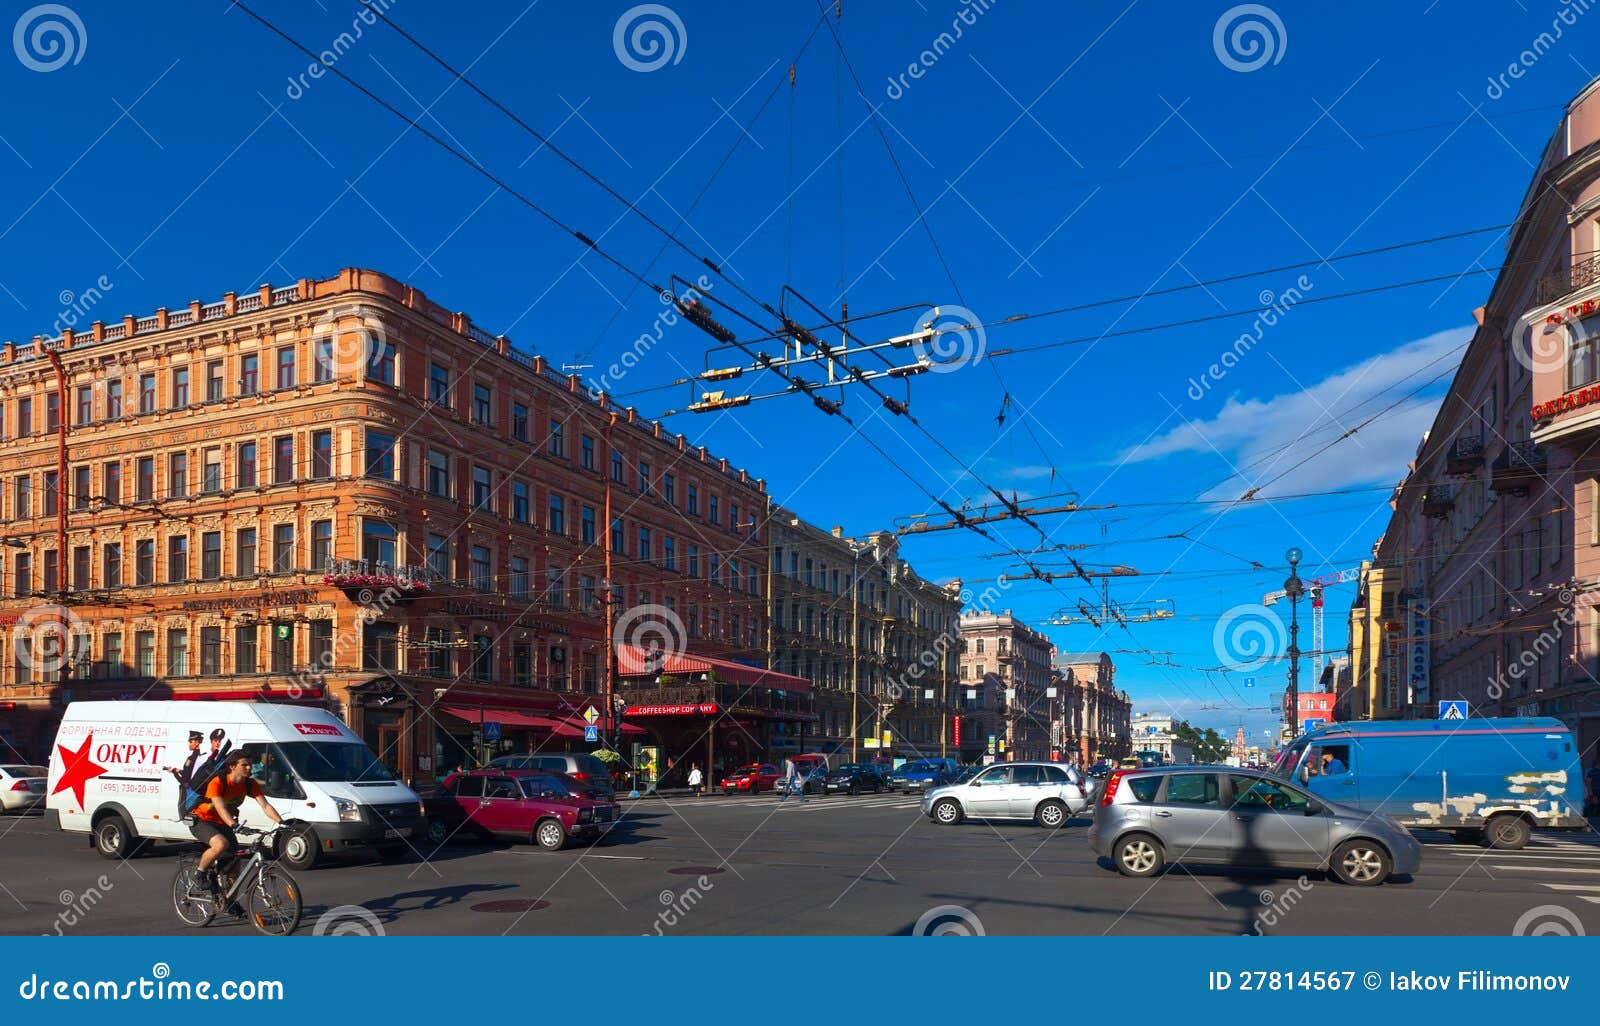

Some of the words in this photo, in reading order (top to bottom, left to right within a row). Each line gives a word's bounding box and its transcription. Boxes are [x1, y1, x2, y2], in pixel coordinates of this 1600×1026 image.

[1546, 298, 1600, 325] ОТЕ
[639, 706, 680, 714] COFFEESHOP
[682, 705, 713, 713] COMANY
[125, 726, 168, 737] ОДЕЖДА
[96, 743, 166, 765] ОКРУГ
[100, 783, 119, 793] (495)
[122, 784, 159, 794] 730-20-95
